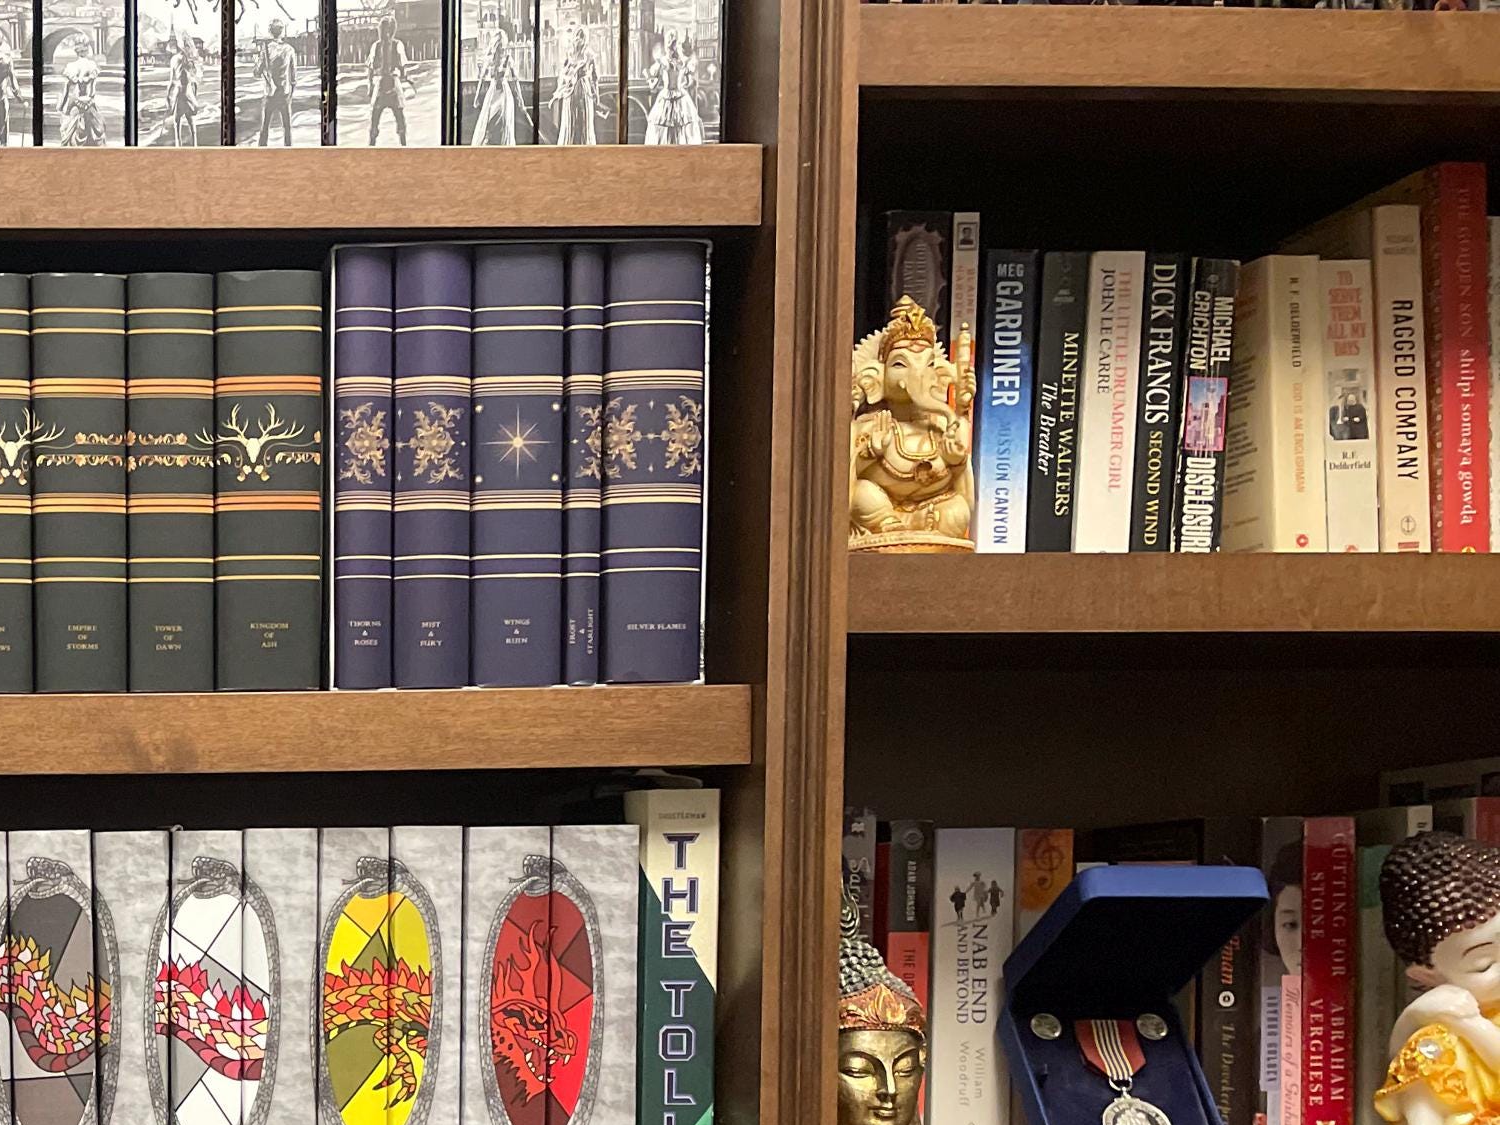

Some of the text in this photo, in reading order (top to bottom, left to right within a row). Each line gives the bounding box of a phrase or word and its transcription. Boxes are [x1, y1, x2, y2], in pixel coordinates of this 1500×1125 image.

[997, 263, 1025, 277] MEG
[1101, 268, 1116, 313] JOHN
[992, 281, 1024, 406] GARDINER
[1100, 316, 1113, 335] LE
[1115, 304, 1131, 362] LITTLE
[1189, 290, 1211, 370] CRICHTON
[1210, 296, 1234, 366] MICHAEL
[1459, 303, 1474, 338] SON
[1038, 382, 1058, 476] The Breaker
[1055, 332, 1080, 516] MINETTE WALTERS
[1110, 366, 1128, 451] DRUMMER
[1144, 264, 1177, 545] DICK FRANCIS SECOND WIND
[1391, 300, 1419, 480] RAGGED COMPANY
[1108, 454, 1123, 493] GIRL
[1329, 461, 1371, 471] Delderfield
[1456, 349, 1477, 525] shilpi somaya gowda
[993, 422, 1012, 544] MISSION CANYON
[660, 832, 700, 958] THE
[1311, 872, 1325, 939] STONE
[1332, 833, 1347, 976] CUTTING FOR
[903, 950, 915, 968] THE
[956, 925, 970, 1024] AND BEYOND
[971, 924, 988, 1024] NAB END
[1282, 988, 1300, 1048] Memoirs
[1309, 998, 1324, 1106] VERGHESE
[1330, 1002, 1345, 1101] ABRAHAM
[958, 1041, 970, 1107] Woodruff
[974, 1048, 985, 1099] William
[1282, 1051, 1297, 1069] of
